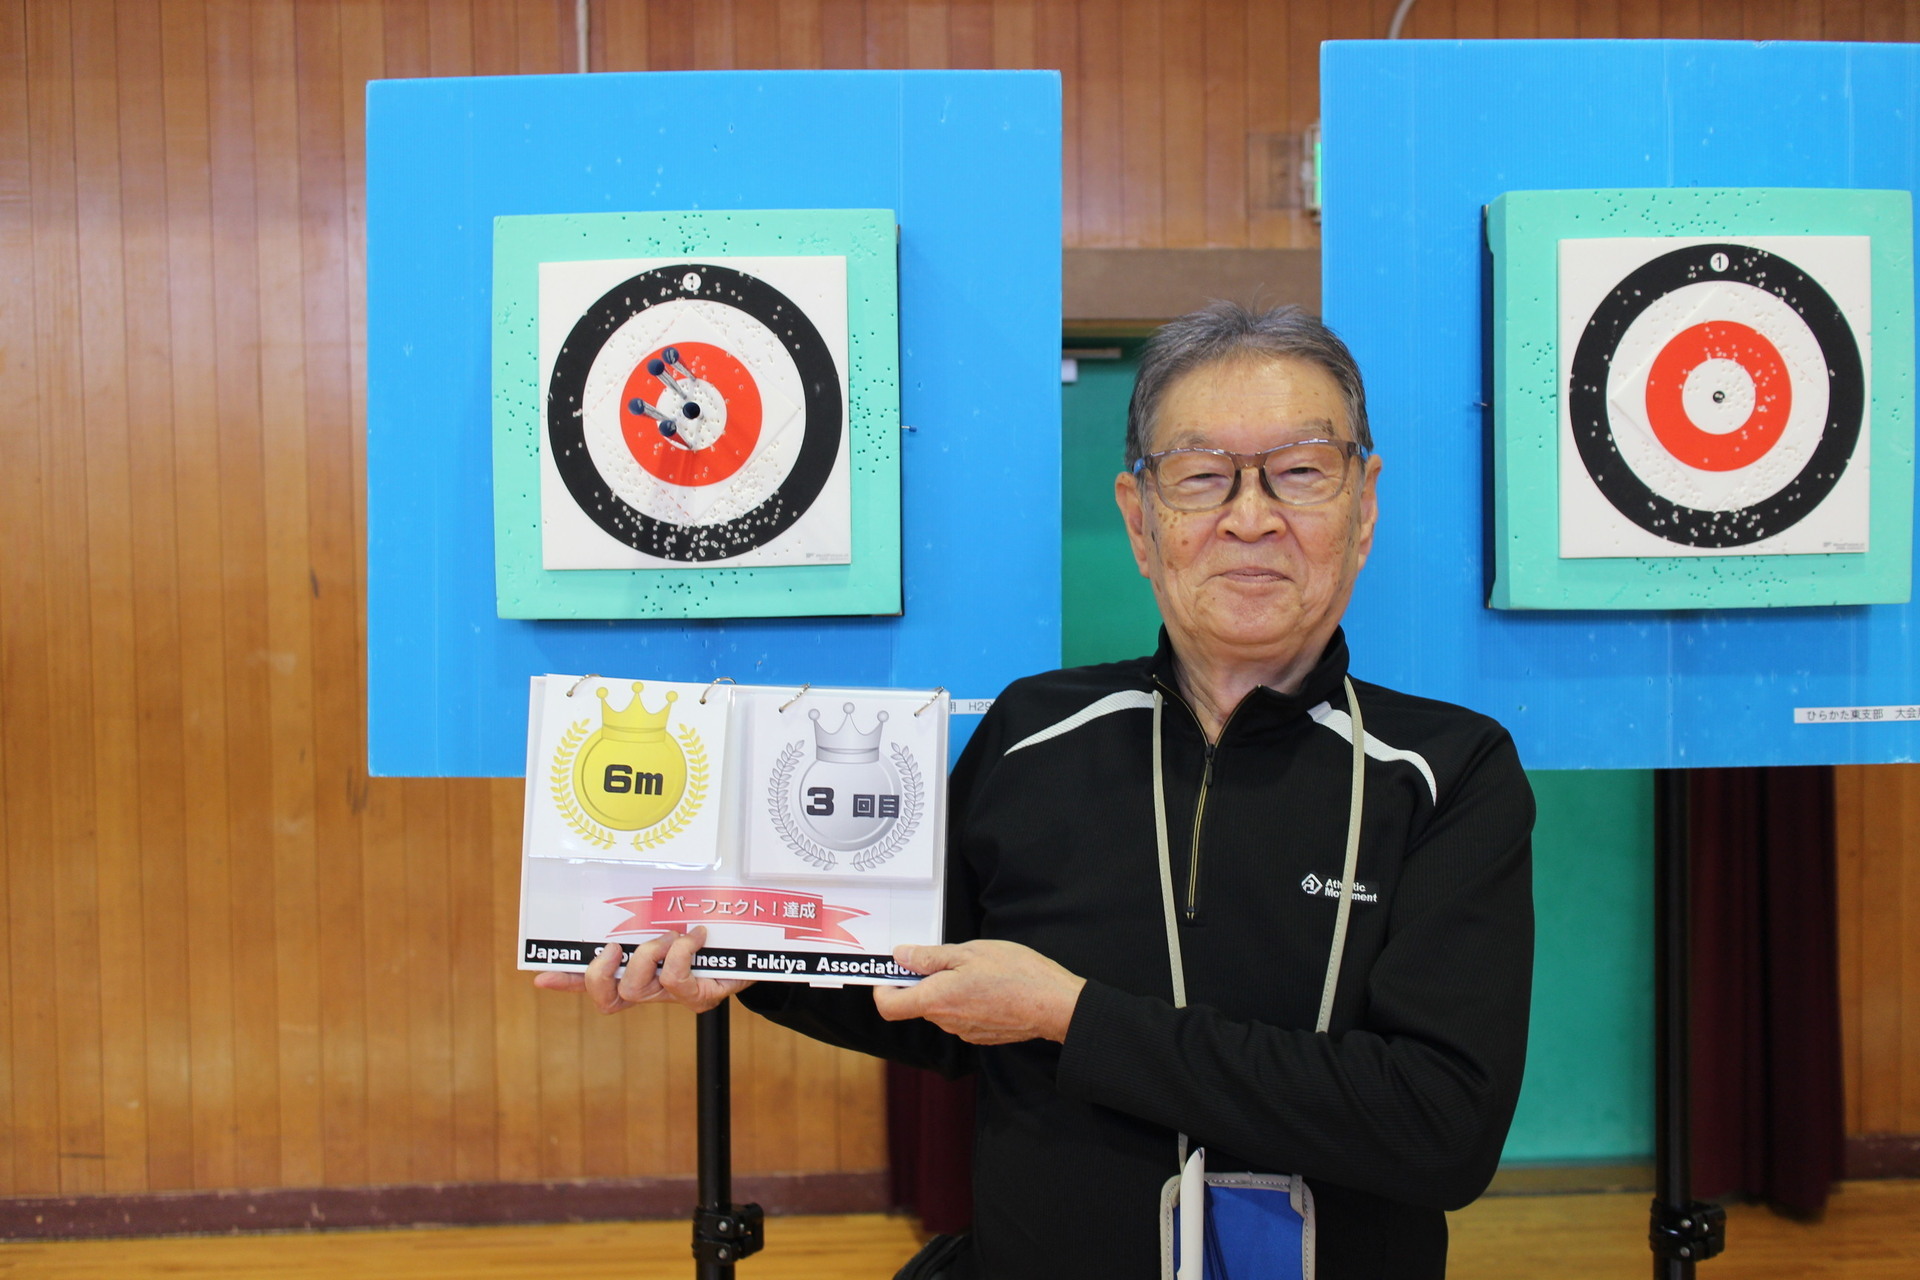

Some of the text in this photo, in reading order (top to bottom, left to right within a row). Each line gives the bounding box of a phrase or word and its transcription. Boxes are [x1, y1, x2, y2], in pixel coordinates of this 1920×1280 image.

[603, 764, 664, 796] 6m
[806, 787, 900, 819] 3 回目
[1324, 887, 1377, 902] Moment
[1325, 878, 1366, 892] Athtic
[526, 943, 582, 963] Japan
[747, 953, 807, 974] Fukiya
[816, 956, 922, 976] Associatio
